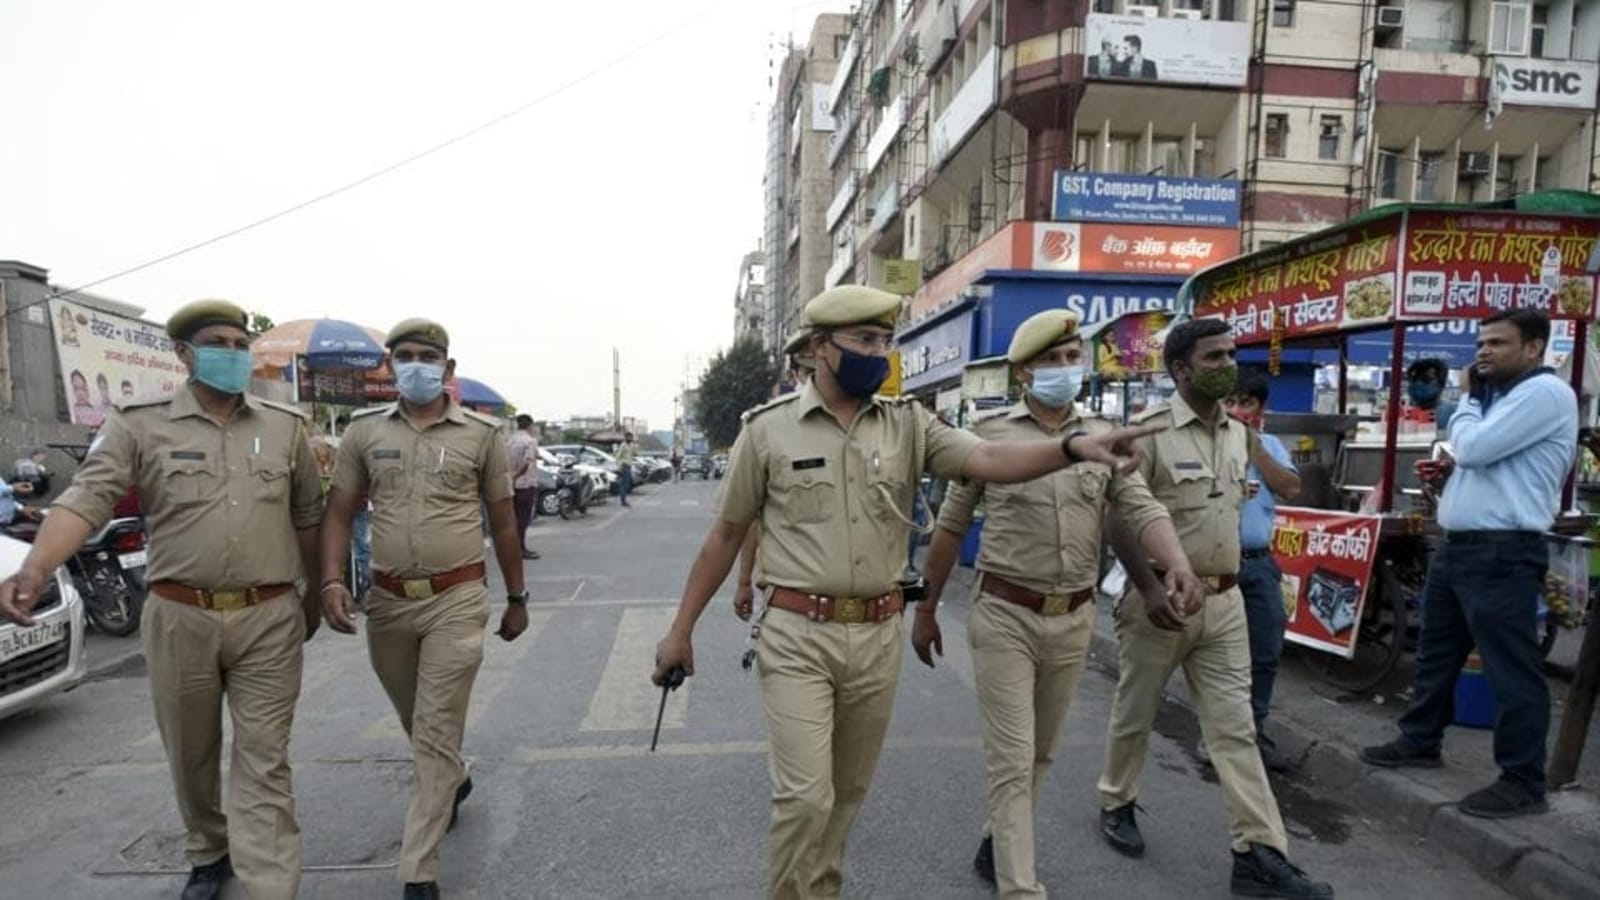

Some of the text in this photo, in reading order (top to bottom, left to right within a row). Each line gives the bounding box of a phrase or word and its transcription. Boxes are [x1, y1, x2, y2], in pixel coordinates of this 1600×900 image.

[1512, 68, 1582, 96] smc
[1062, 176, 1237, 203] GST, Company Registration
[1258, 264, 1281, 293] का
[1346, 230, 1392, 272] पोहा
[1470, 231, 1498, 262] का
[1499, 233, 1555, 276] मशहू
[1484, 271, 1515, 311] पोहा
